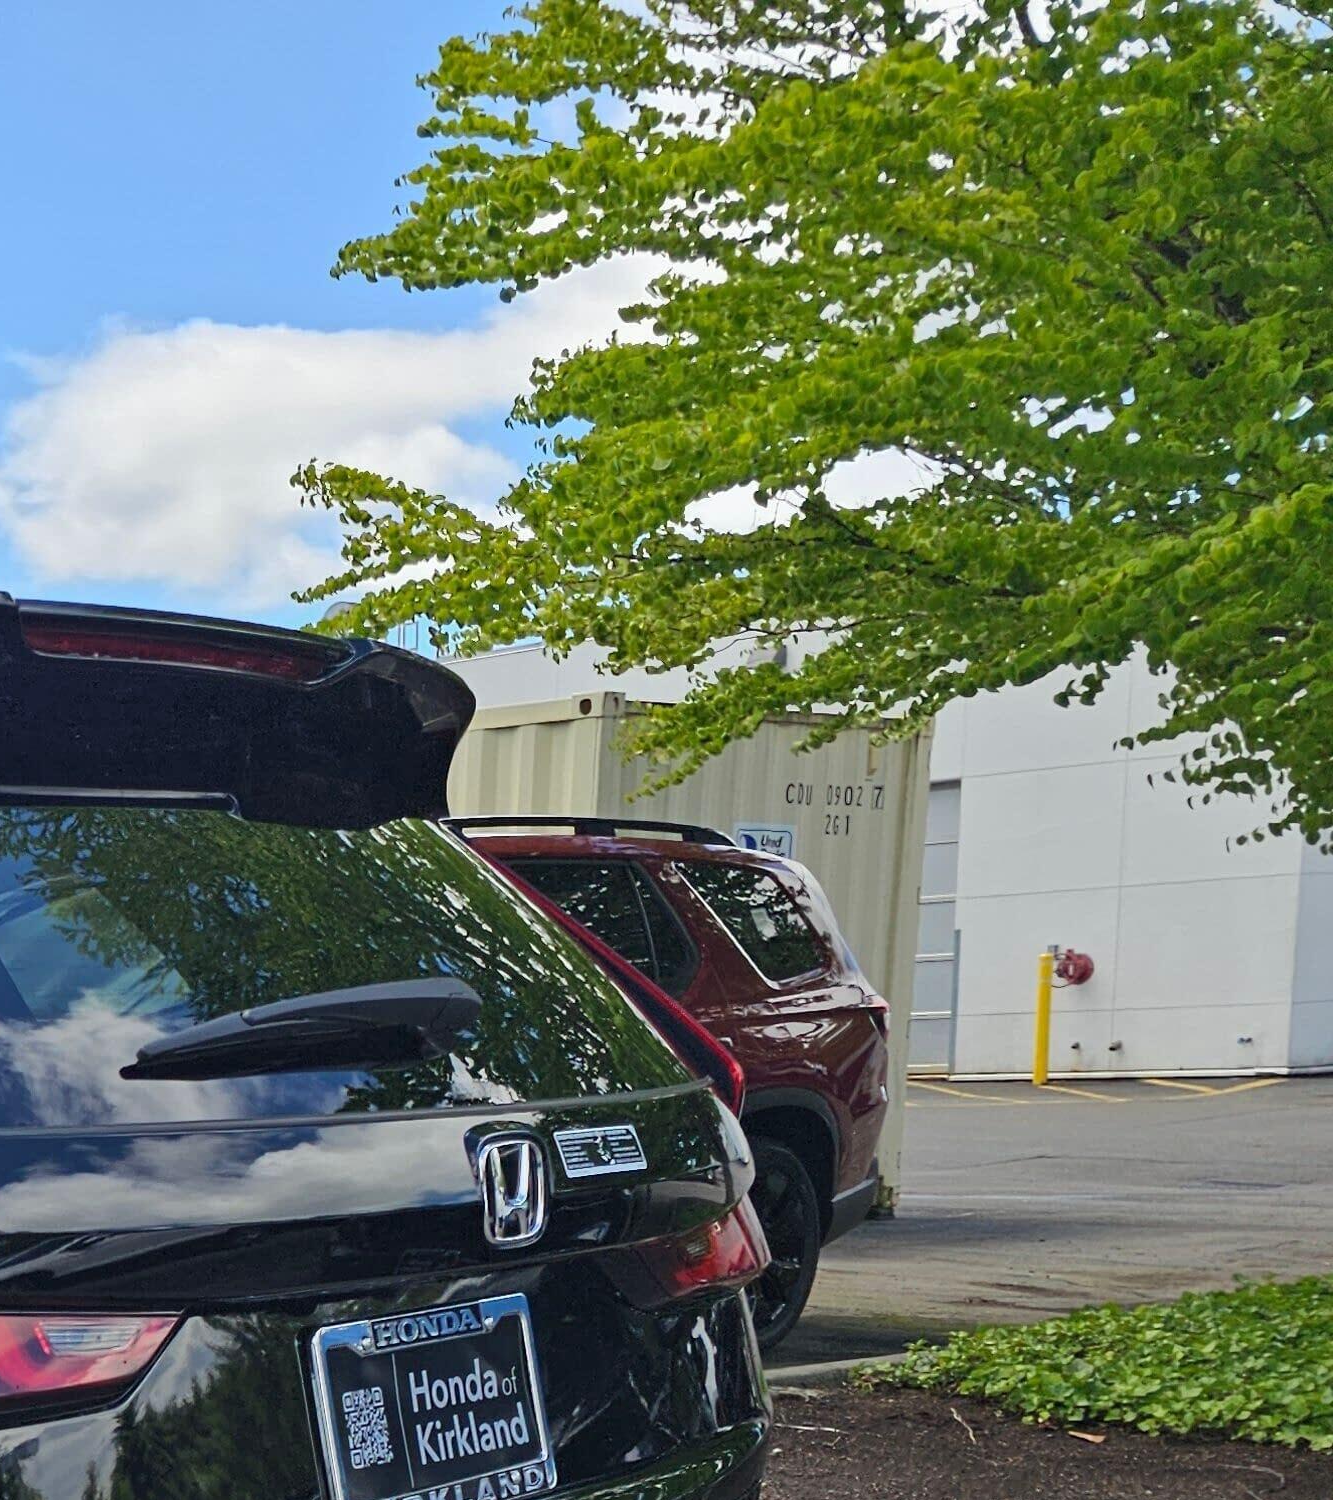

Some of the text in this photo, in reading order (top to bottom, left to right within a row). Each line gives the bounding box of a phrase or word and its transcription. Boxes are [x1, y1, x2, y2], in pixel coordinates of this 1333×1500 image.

[374, 1306, 482, 1348] HONDA
[408, 1358, 519, 1413] Honda of
[414, 1402, 530, 1466] Kirkland
